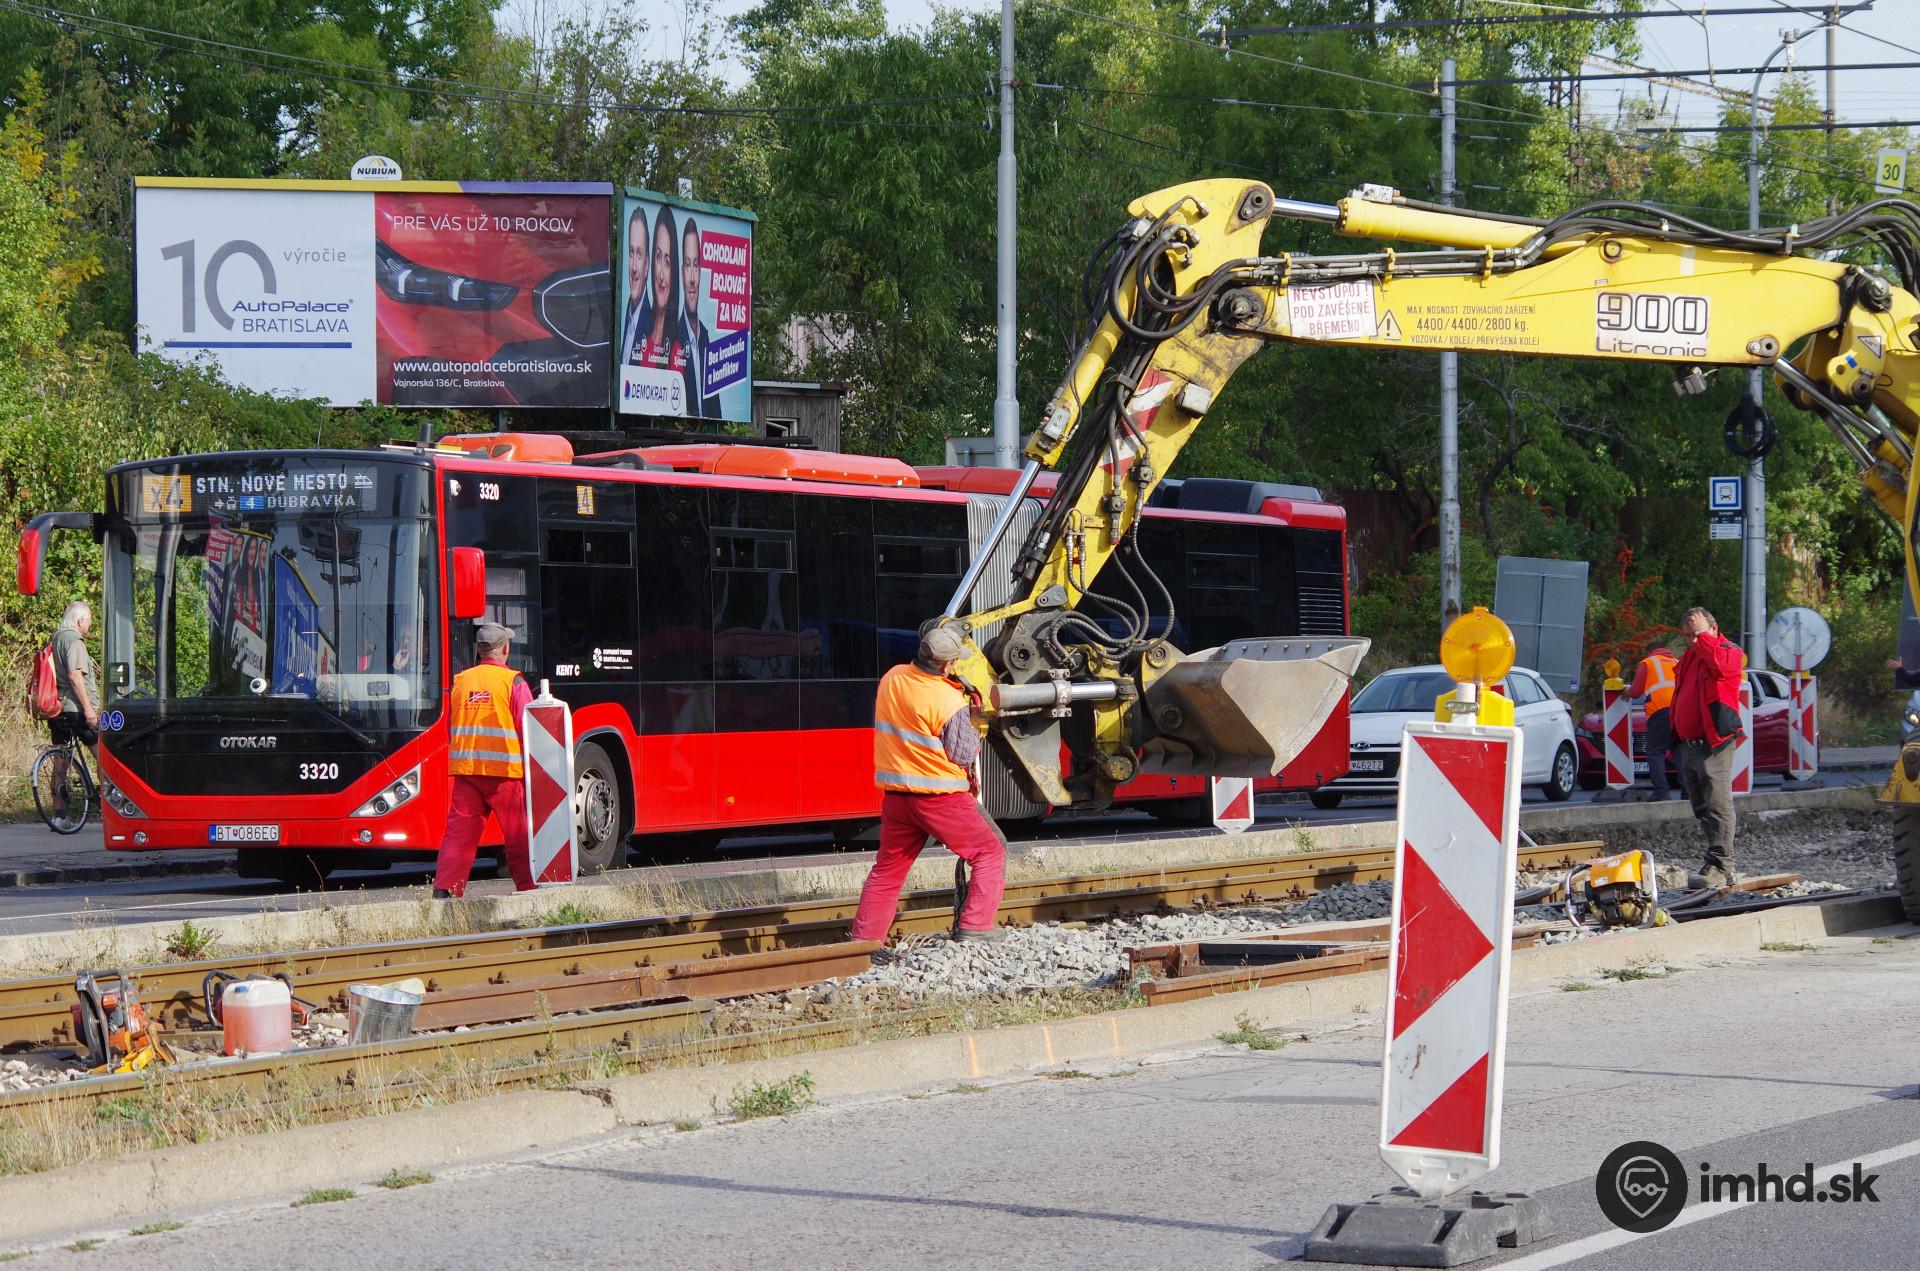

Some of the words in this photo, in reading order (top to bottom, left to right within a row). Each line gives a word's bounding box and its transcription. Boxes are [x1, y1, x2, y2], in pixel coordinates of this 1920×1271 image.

[357, 167, 397, 175] NUBIUM
[1882, 163, 1900, 181] 30
[392, 215, 426, 231] PRE
[429, 212, 462, 231] VÁS
[466, 213, 489, 231] UŽ
[492, 217, 510, 232] 10
[515, 217, 574, 232] ROKOV.
[282, 247, 347, 264] výročie
[702, 241, 748, 267] ODHODLANÍ
[160, 238, 277, 334] 10
[712, 271, 747, 295] BOJOVAŤ
[719, 302, 731, 322] ZA
[731, 299, 747, 324] VÁS
[1293, 305, 1314, 319] POD
[1426, 304, 1459, 315] NOSNOST
[1596, 291, 1709, 336] 900
[242, 318, 349, 333] BRATISLAVA
[1514, 317, 1530, 332] kg.
[1410, 334, 1443, 344] VOZOVKA
[1449, 336, 1471, 345] KOLEJ
[1519, 336, 1541, 346] KOLEJ
[1595, 336, 1707, 357] Litronic
[393, 359, 592, 374] www.autopalacebratislava.sk
[393, 378, 434, 387] Vajnorská
[463, 378, 505, 387] Bratislava
[631, 383, 668, 402] DEMOKRATI
[671, 386, 680, 401] 22
[196, 476, 234, 493] STN.
[241, 472, 286, 492] NOVÉ
[479, 482, 500, 501] 3320
[246, 496, 256, 509] 4
[267, 493, 356, 508] DÚBRAVKA
[555, 664, 574, 676] KENT
[574, 664, 580, 676] C
[219, 736, 277, 748] OTOKAR
[299, 762, 339, 780] 3320
